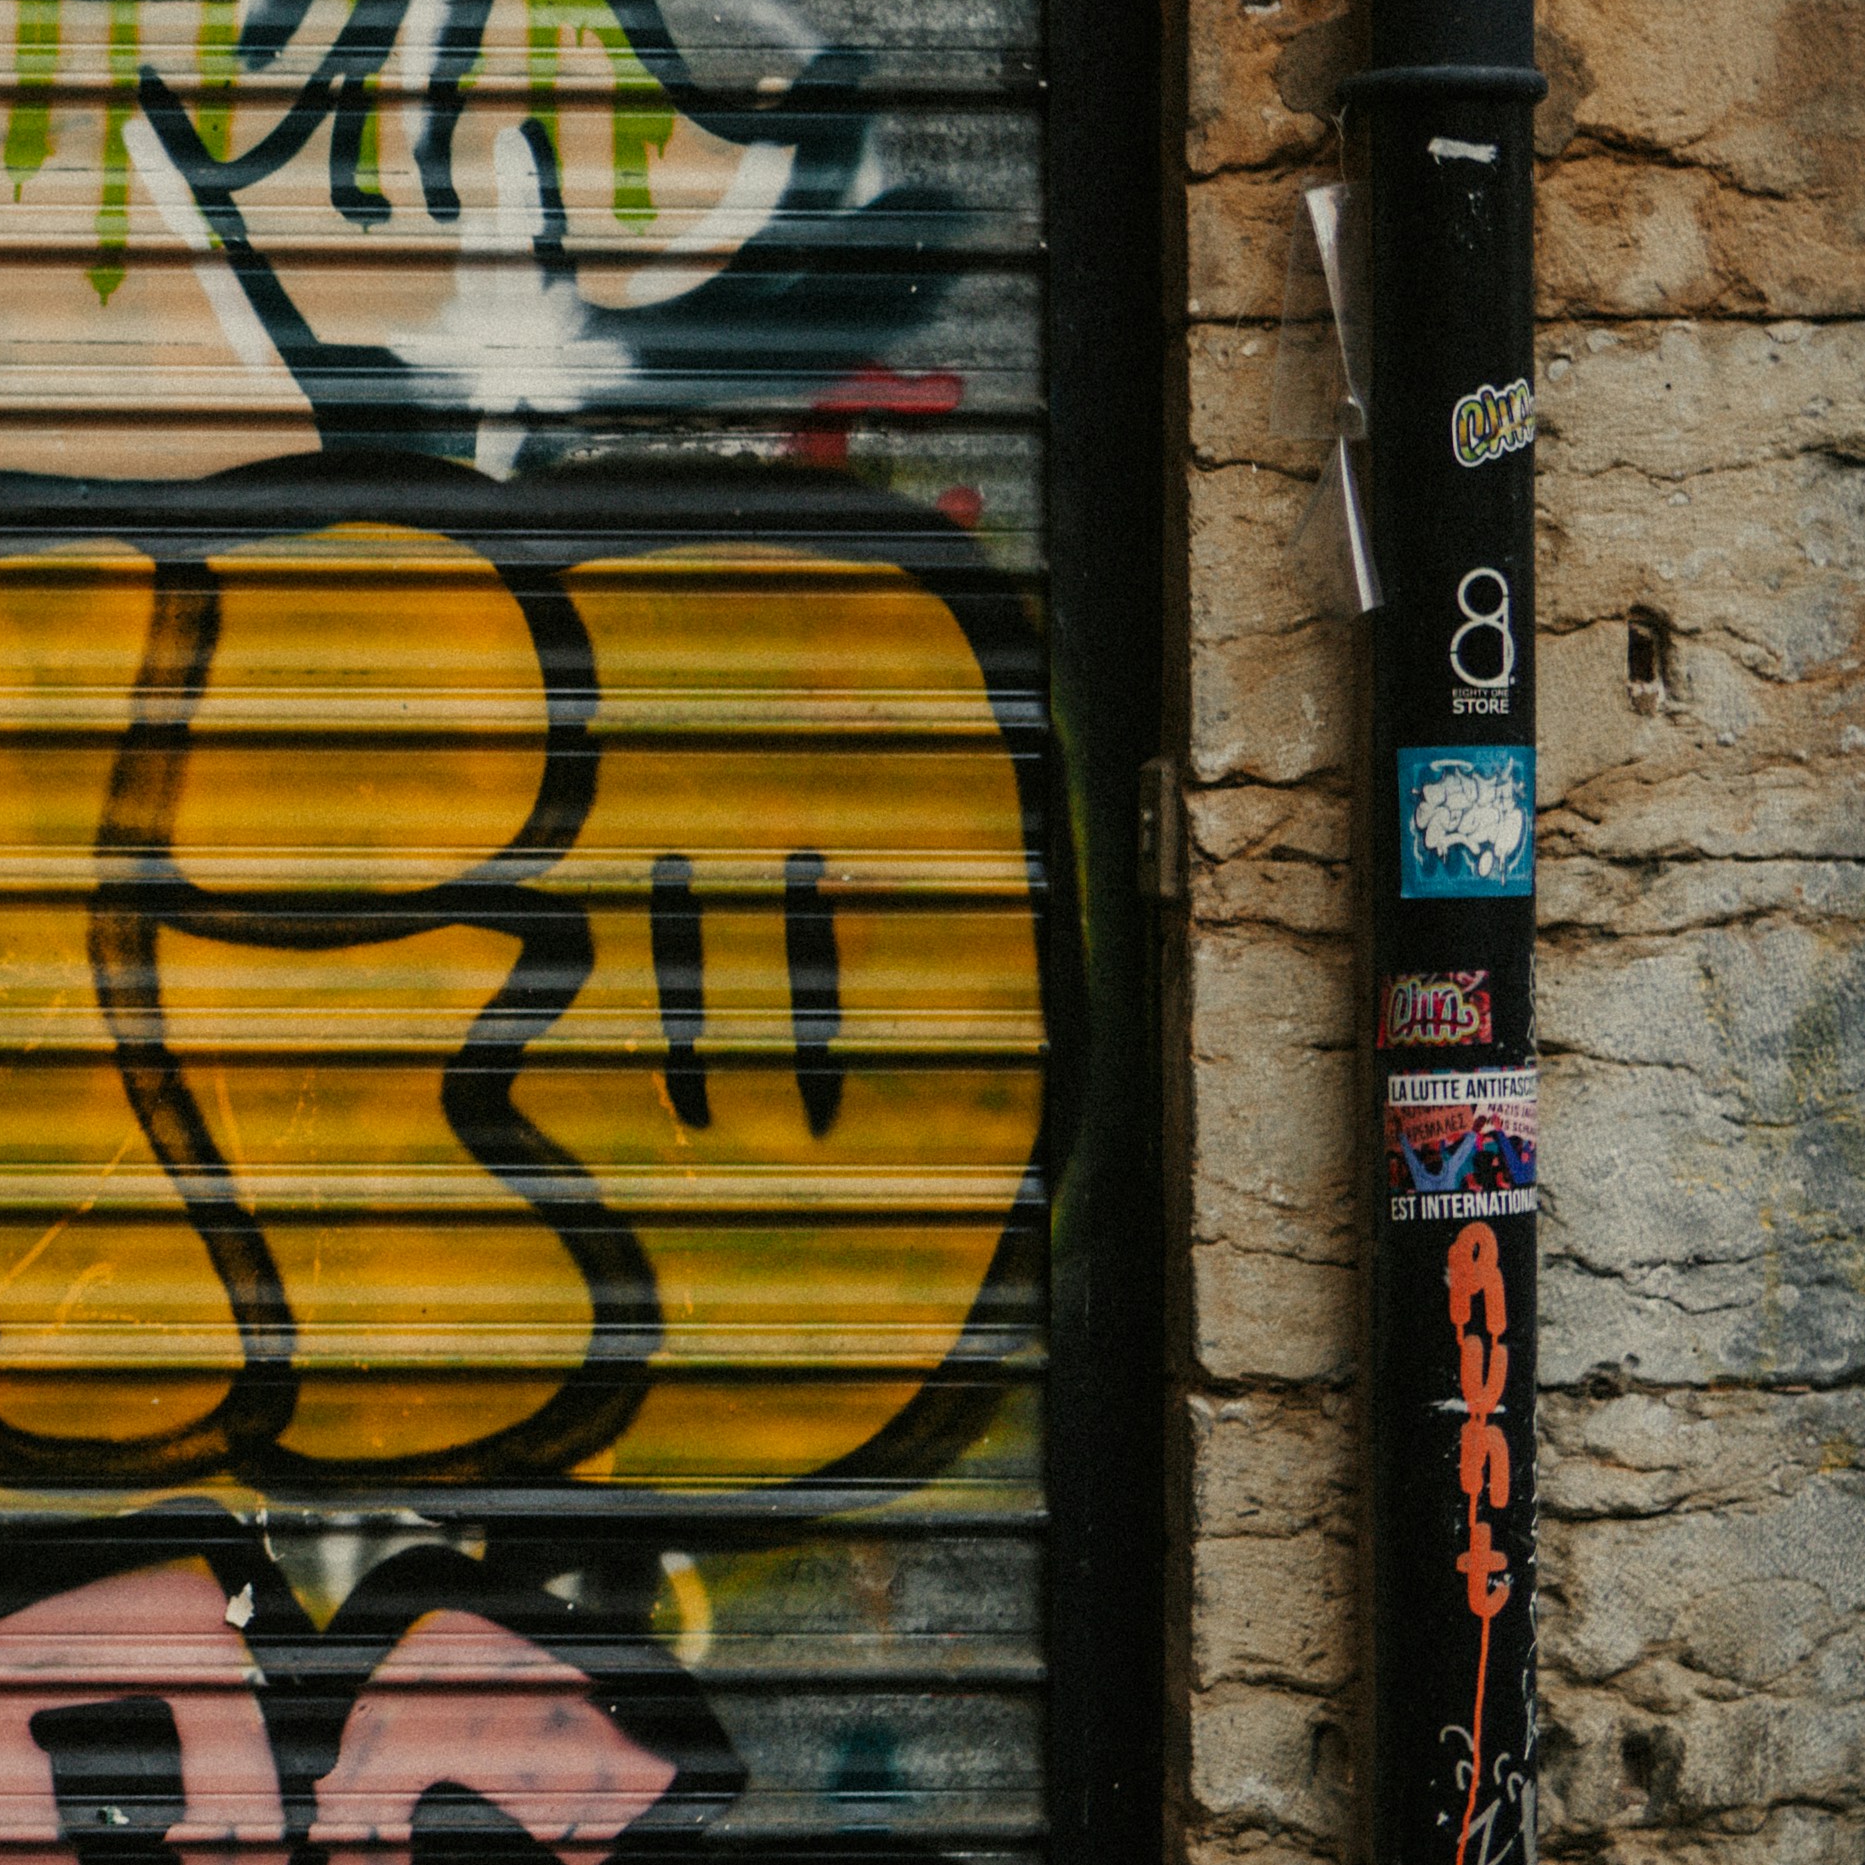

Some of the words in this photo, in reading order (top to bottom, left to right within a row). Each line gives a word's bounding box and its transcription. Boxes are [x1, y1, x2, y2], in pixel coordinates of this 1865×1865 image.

[1490, 688, 1509, 697] ONE
[1452, 698, 1509, 714] STORE
[1392, 1080, 1407, 1101] LA
[1411, 1079, 1460, 1100] LUTTE
[1391, 1197, 1416, 1220] EST
